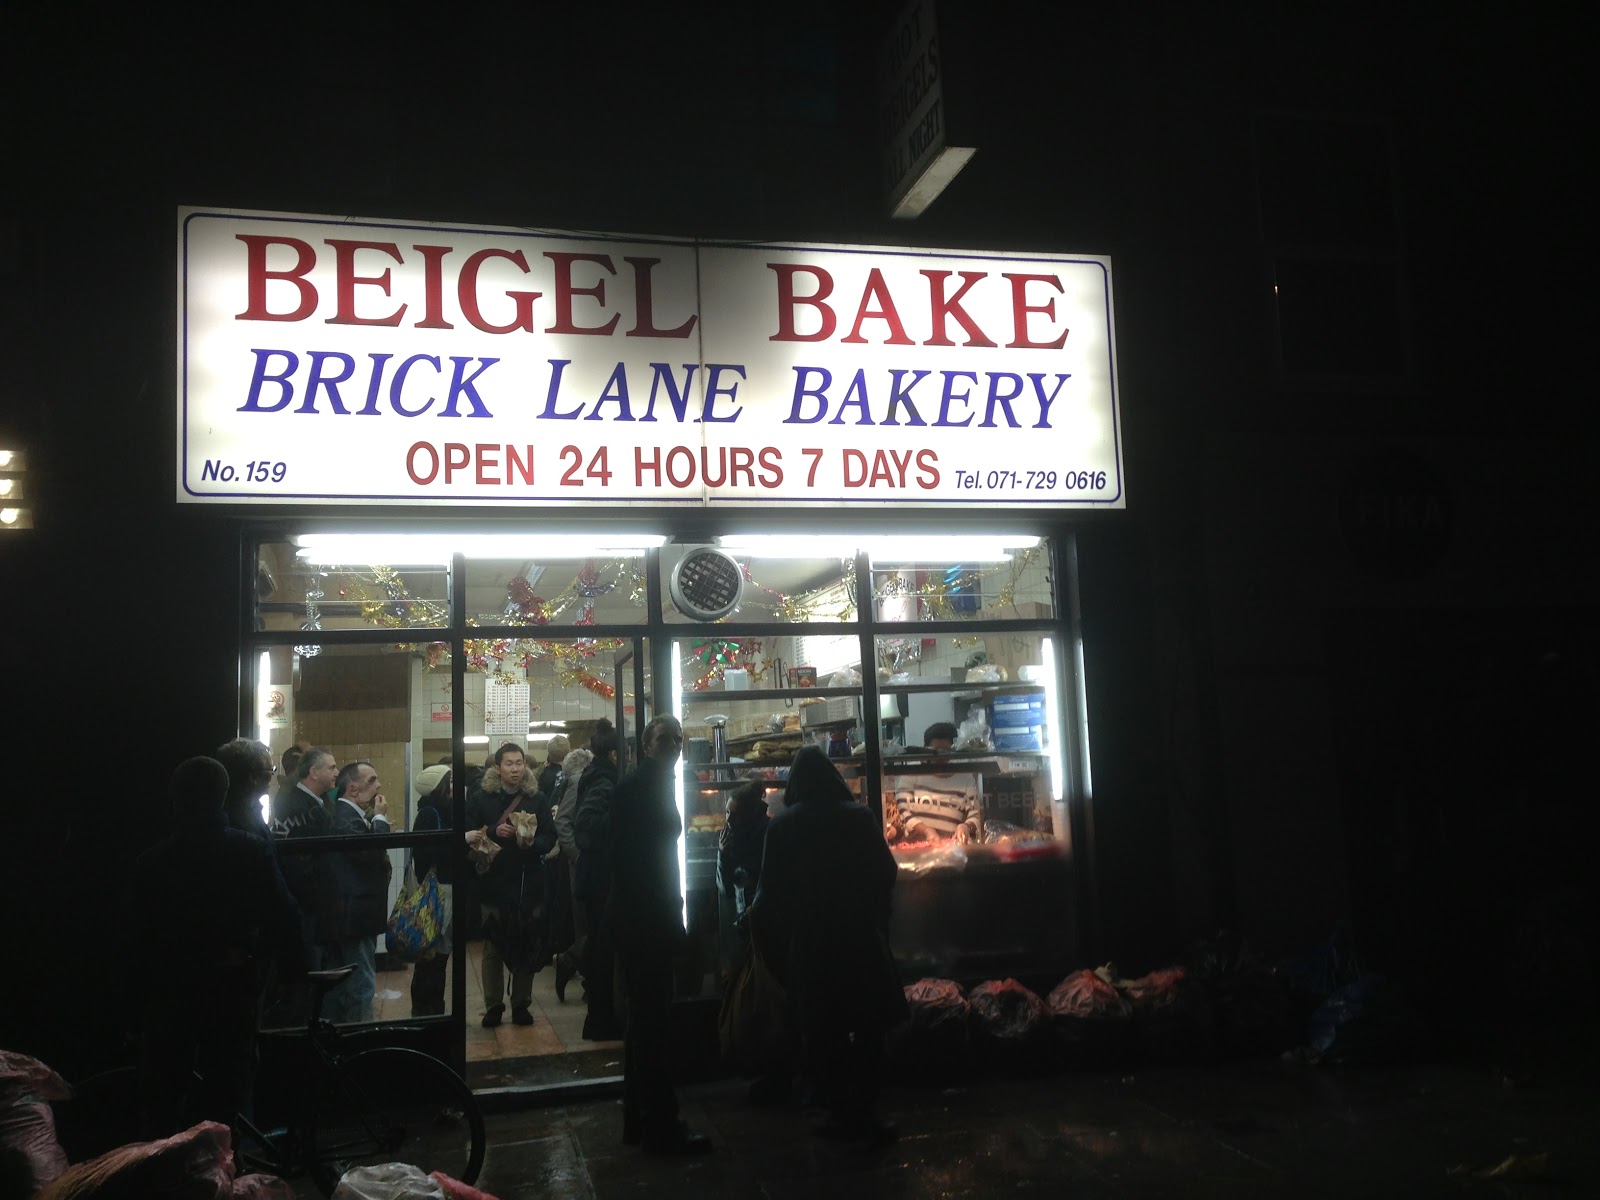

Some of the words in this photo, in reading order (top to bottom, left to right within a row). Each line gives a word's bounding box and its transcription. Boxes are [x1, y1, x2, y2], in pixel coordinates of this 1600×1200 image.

[909, 99, 940, 167] NIGHT
[235, 234, 698, 339] BEIGEL
[767, 263, 1070, 350] BAKE
[236, 348, 500, 418] BRICK
[536, 359, 747, 423] LANE
[782, 366, 1071, 428] BAKERY
[406, 441, 535, 486] OPEN
[559, 445, 613, 487] 24
[635, 446, 784, 489] HOURS
[801, 448, 824, 488] 7
[843, 449, 941, 490] DAYS
[1065, 471, 1107, 491] 0616
[1358, 494, 1445, 529] FIKA
